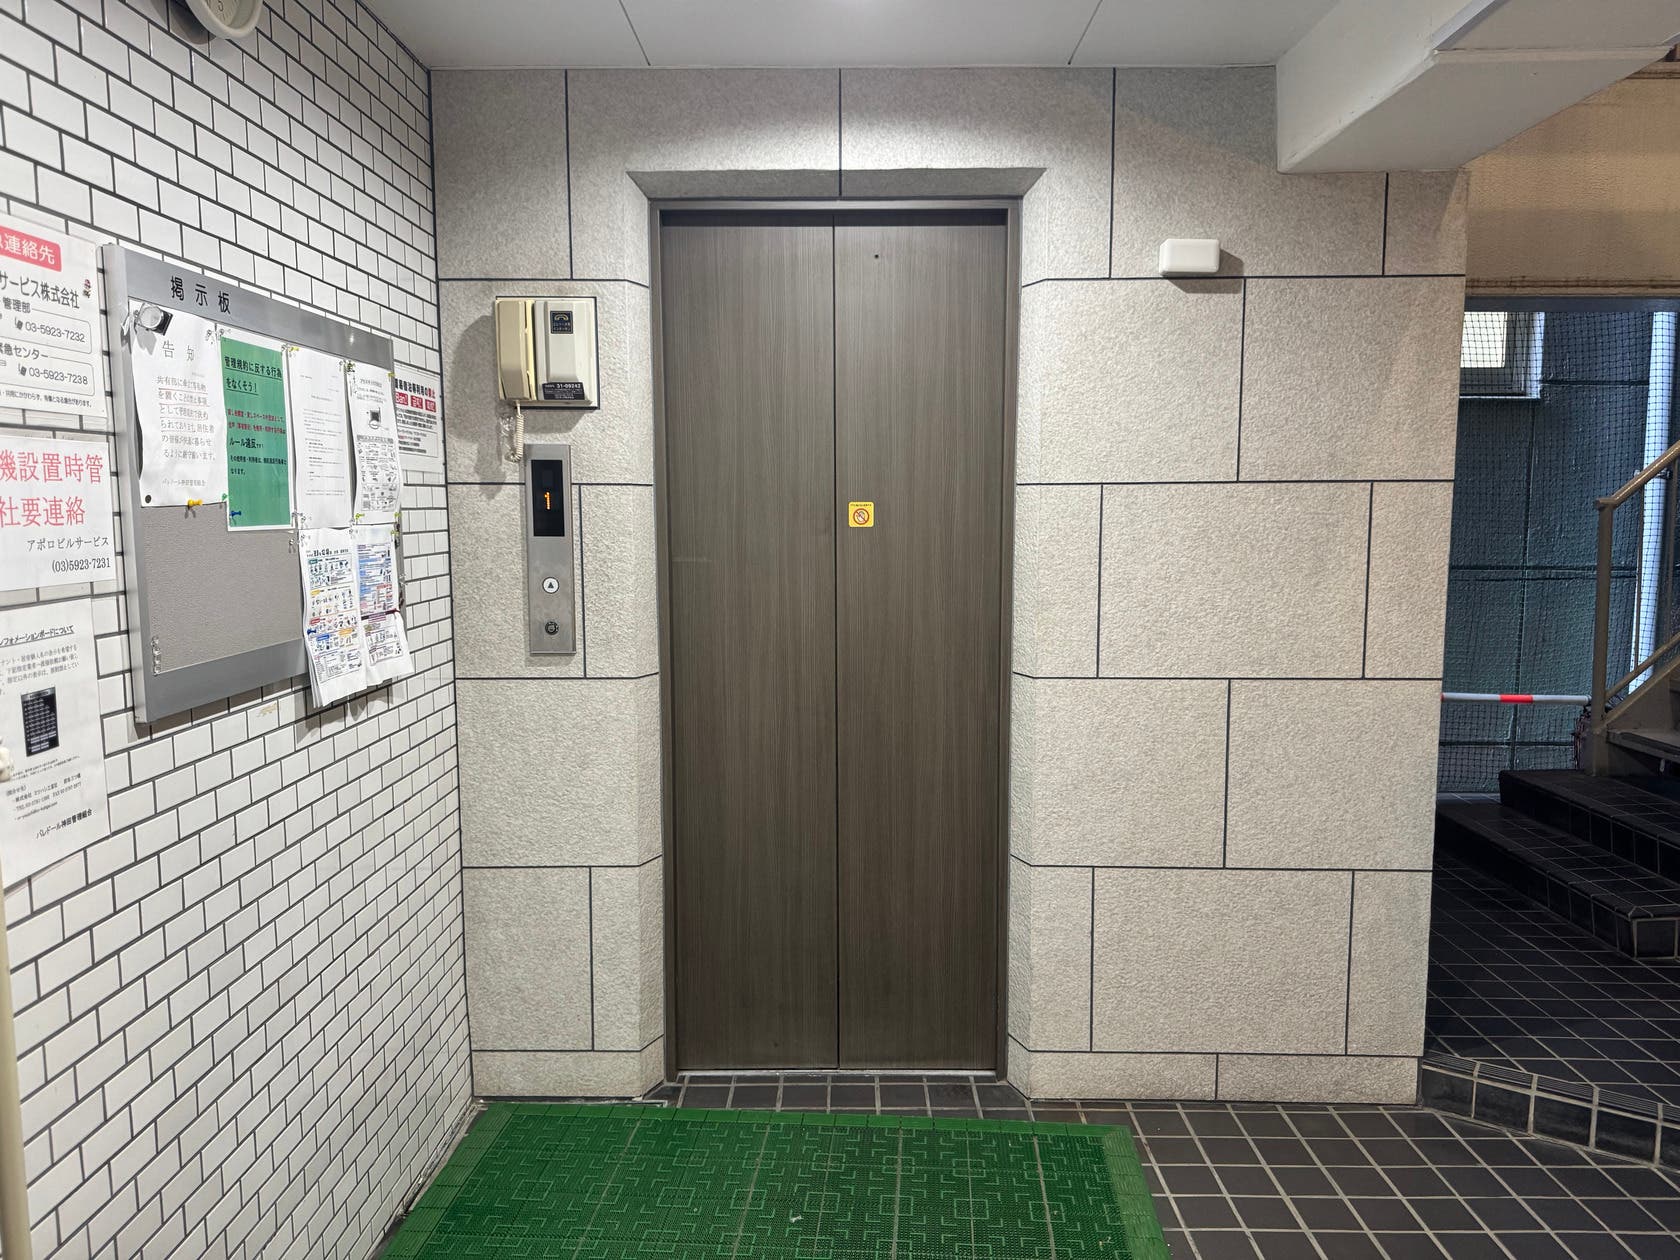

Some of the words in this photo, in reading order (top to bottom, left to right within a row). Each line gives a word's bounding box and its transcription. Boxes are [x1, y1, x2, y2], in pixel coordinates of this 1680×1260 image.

[0, 232, 55, 265] 連絡先
[25, 321, 86, 343] 03-5923-7232
[29, 366, 89, 386] 03-5923-7238
[544, 492, 551, 510] 1
[27, 536, 109, 552] アポロビルサービス
